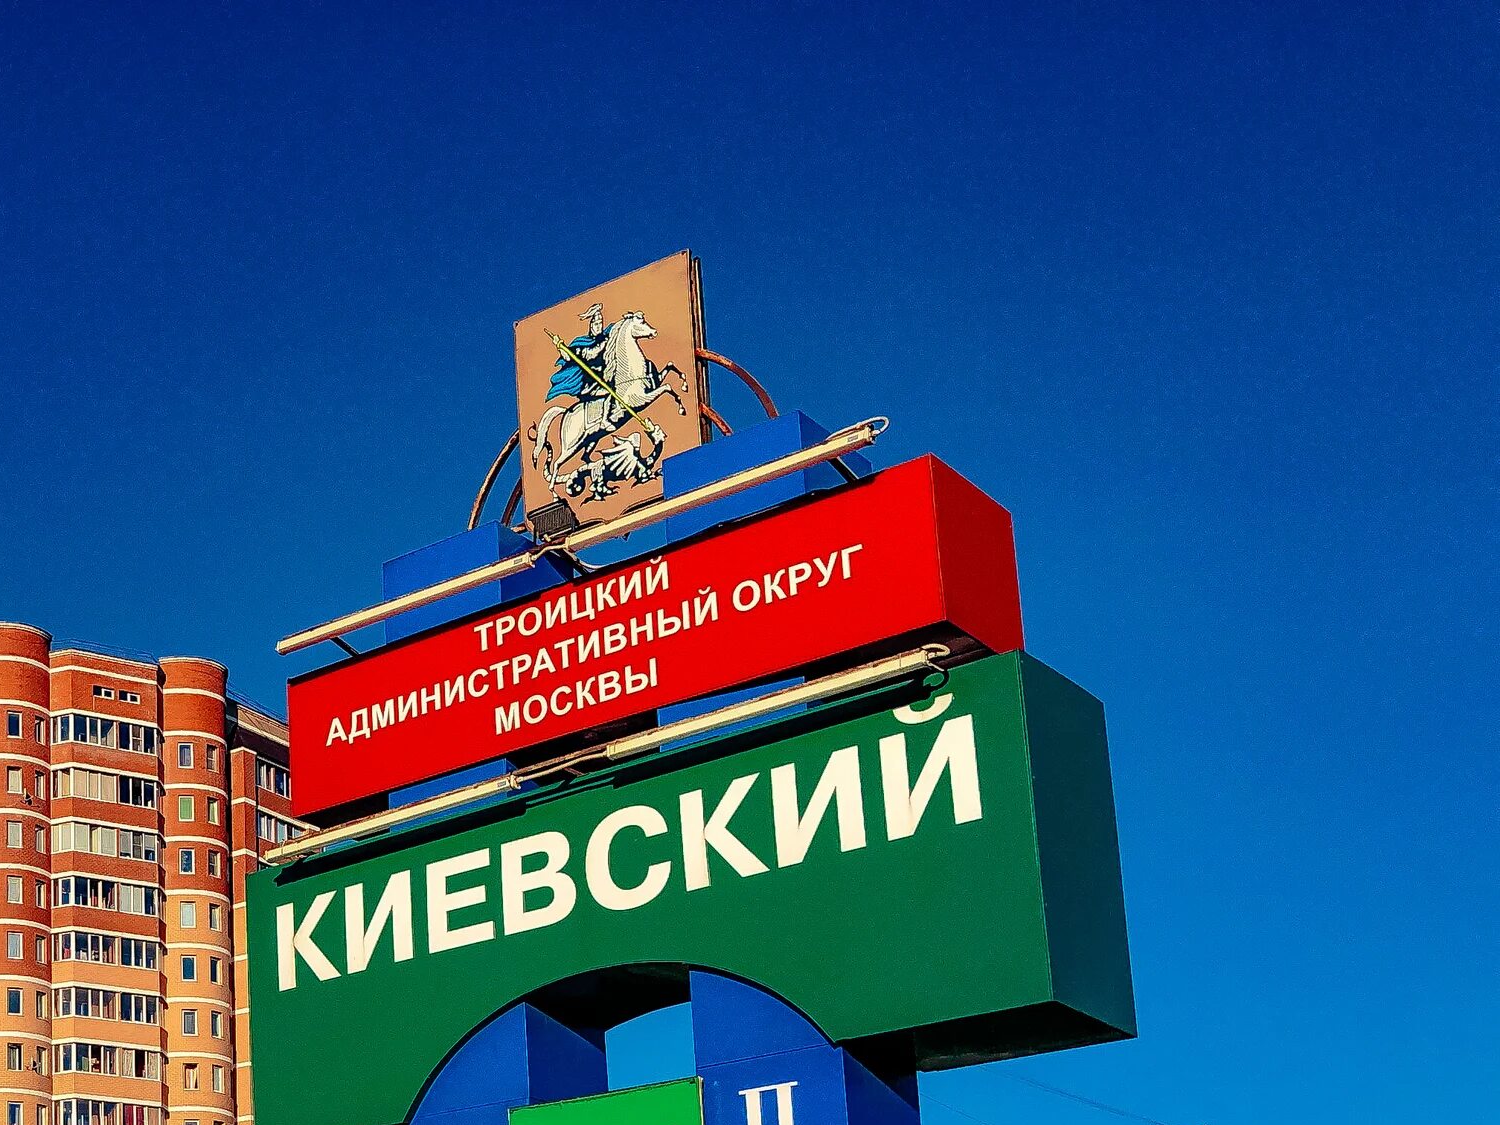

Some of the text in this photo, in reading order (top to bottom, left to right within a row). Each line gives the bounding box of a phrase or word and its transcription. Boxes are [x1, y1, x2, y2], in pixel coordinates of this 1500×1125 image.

[327, 544, 863, 746] АДМИНИСТРАТИВНЫЙ ОКРУГ
[473, 558, 671, 653] ТРОИЦКИЙ
[495, 658, 658, 735] МОСКВЫ
[276, 693, 983, 992] КИЕВСКИЙ
